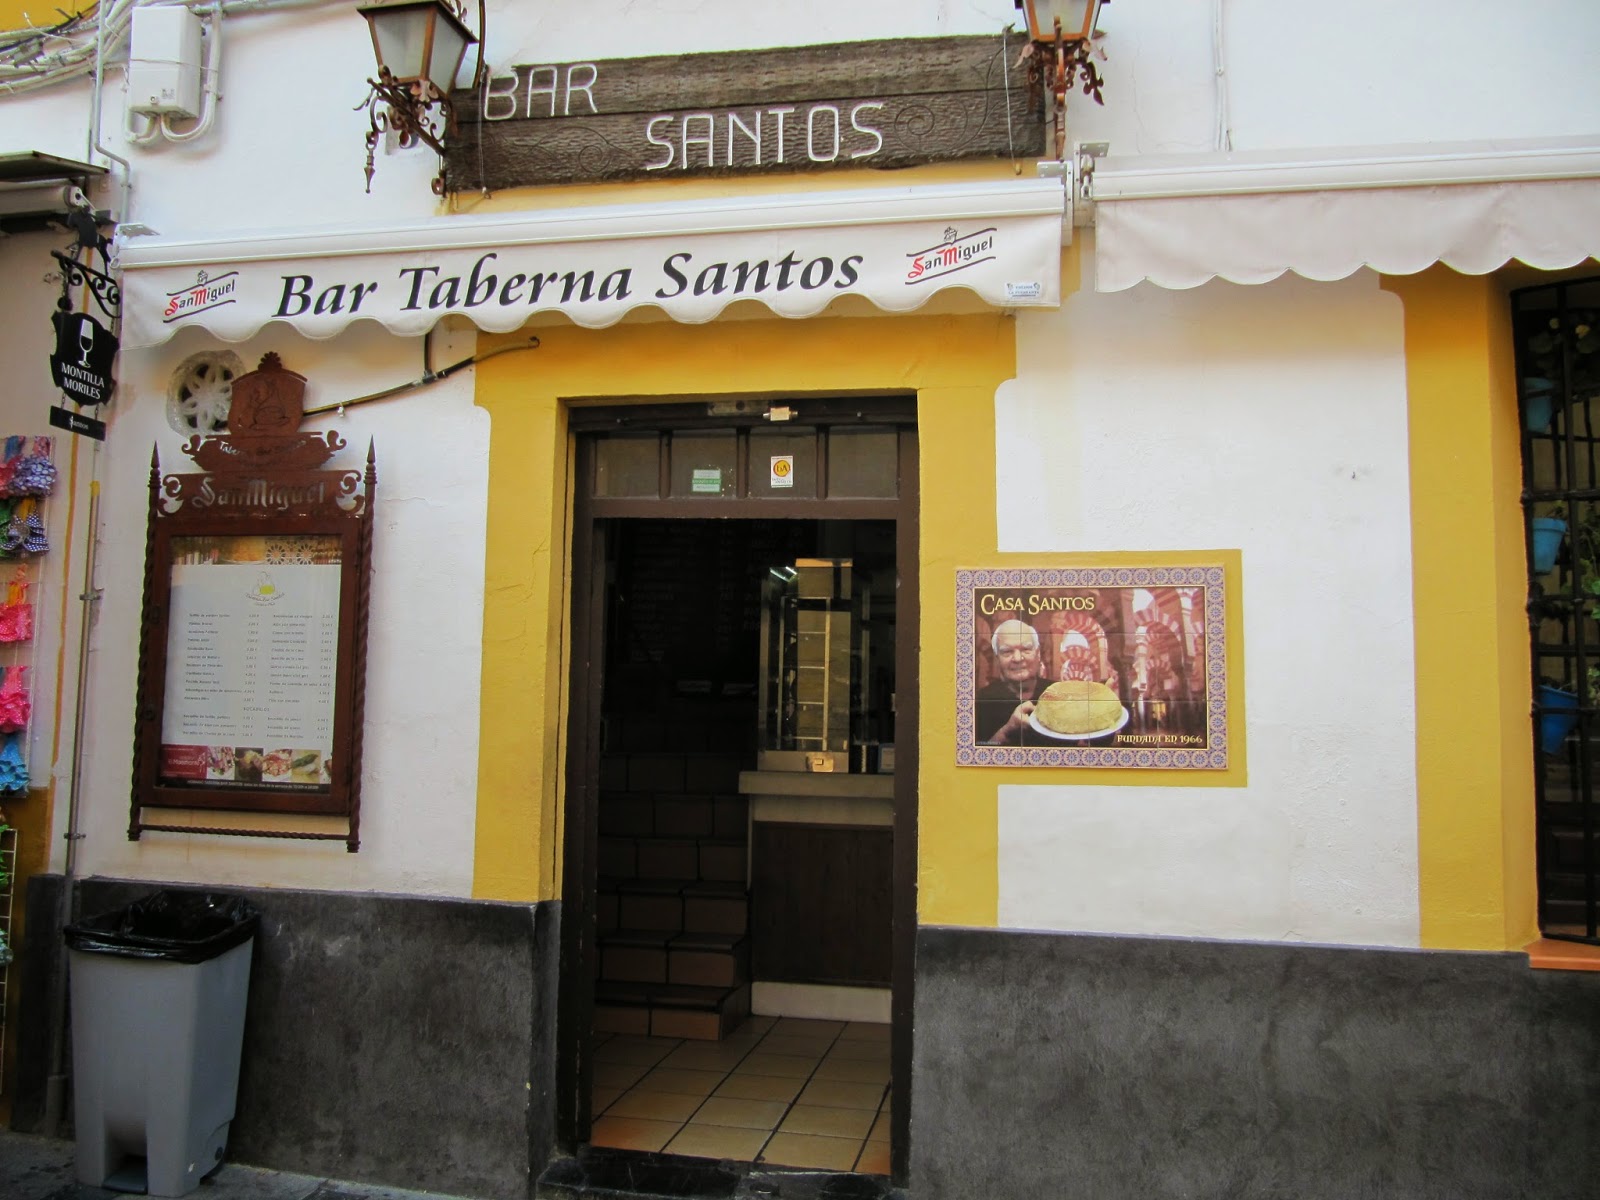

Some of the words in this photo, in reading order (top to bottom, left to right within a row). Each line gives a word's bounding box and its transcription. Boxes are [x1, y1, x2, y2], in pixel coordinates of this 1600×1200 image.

[484, 63, 598, 121] BAR
[645, 102, 884, 171] SANTOS
[271, 274, 378, 318] Bar
[398, 252, 633, 311] Taberna
[655, 250, 864, 299] Santos
[61, 361, 105, 388] MONTILLA
[63, 377, 101, 400] MORILES
[980, 594, 1025, 615] CASA
[1028, 594, 1095, 615] SANTOS
[1117, 734, 1161, 745] FUNDADA
[1164, 734, 1178, 745] EN
[1180, 735, 1203, 744] 1966
